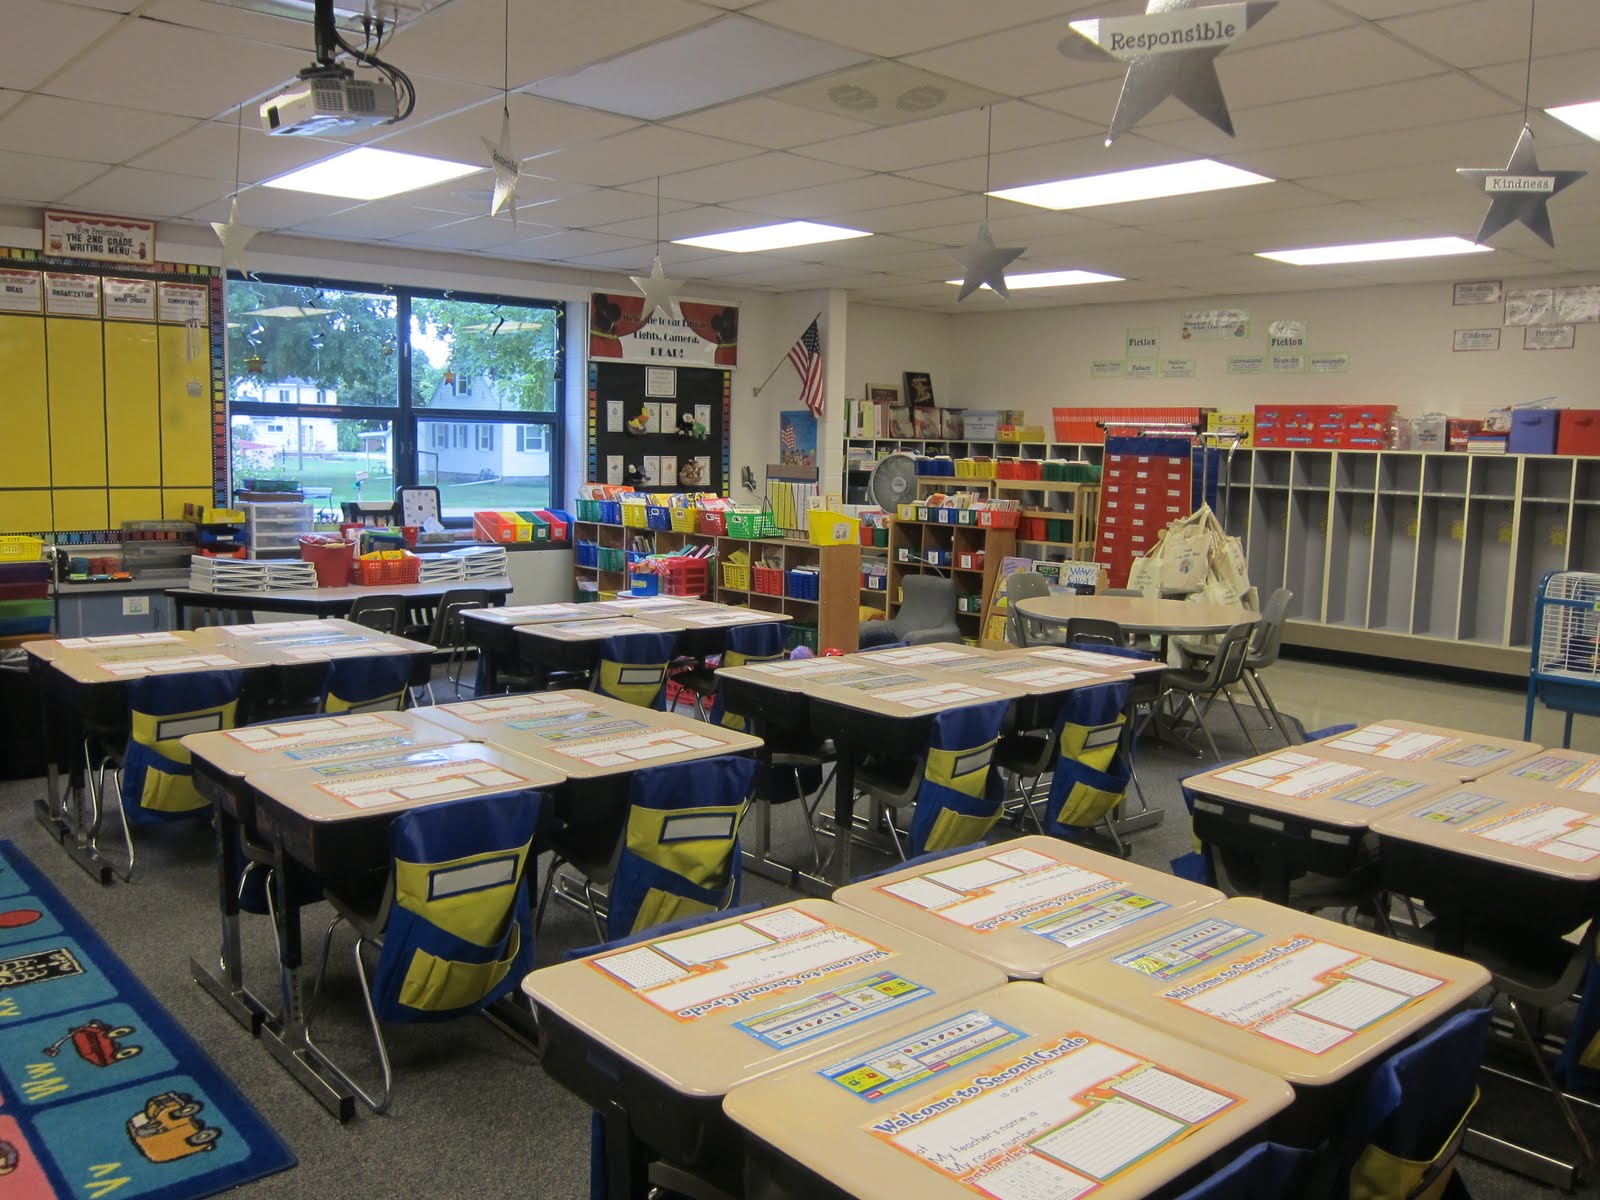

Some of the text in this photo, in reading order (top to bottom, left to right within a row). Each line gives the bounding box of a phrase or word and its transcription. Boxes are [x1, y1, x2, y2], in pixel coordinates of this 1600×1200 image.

[1110, 20, 1236, 50] Responsible
[1492, 178, 1549, 190] Kindness
[66, 232, 134, 248] THE 2ND GRADE
[68, 243, 130, 256] WRITING MENU
[6, 286, 24, 294] IDEAS
[52, 289, 94, 298] ORGANIZATION
[658, 317, 666, 325] to
[633, 331, 700, 344] Lights, Camera,
[1128, 338, 1156, 346] Fiction
[1271, 338, 1303, 346] Fiction
[650, 346, 684, 358] READ!
[1164, 938, 1313, 1000] Welcome to Second Grade
[678, 950, 890, 1018] Welcome to Second Grade
[1024, 1068, 1054, 1087] official
[874, 1036, 1088, 1134] Welcome to Second Grade
[928, 1152, 956, 1165] My
[950, 1128, 1000, 1153] teacher's
[1000, 1116, 1028, 1131] name
[916, 1144, 928, 1155] at
[945, 1162, 974, 1175] My
[972, 1146, 1001, 1163] room
[1002, 1126, 1038, 1148] number
